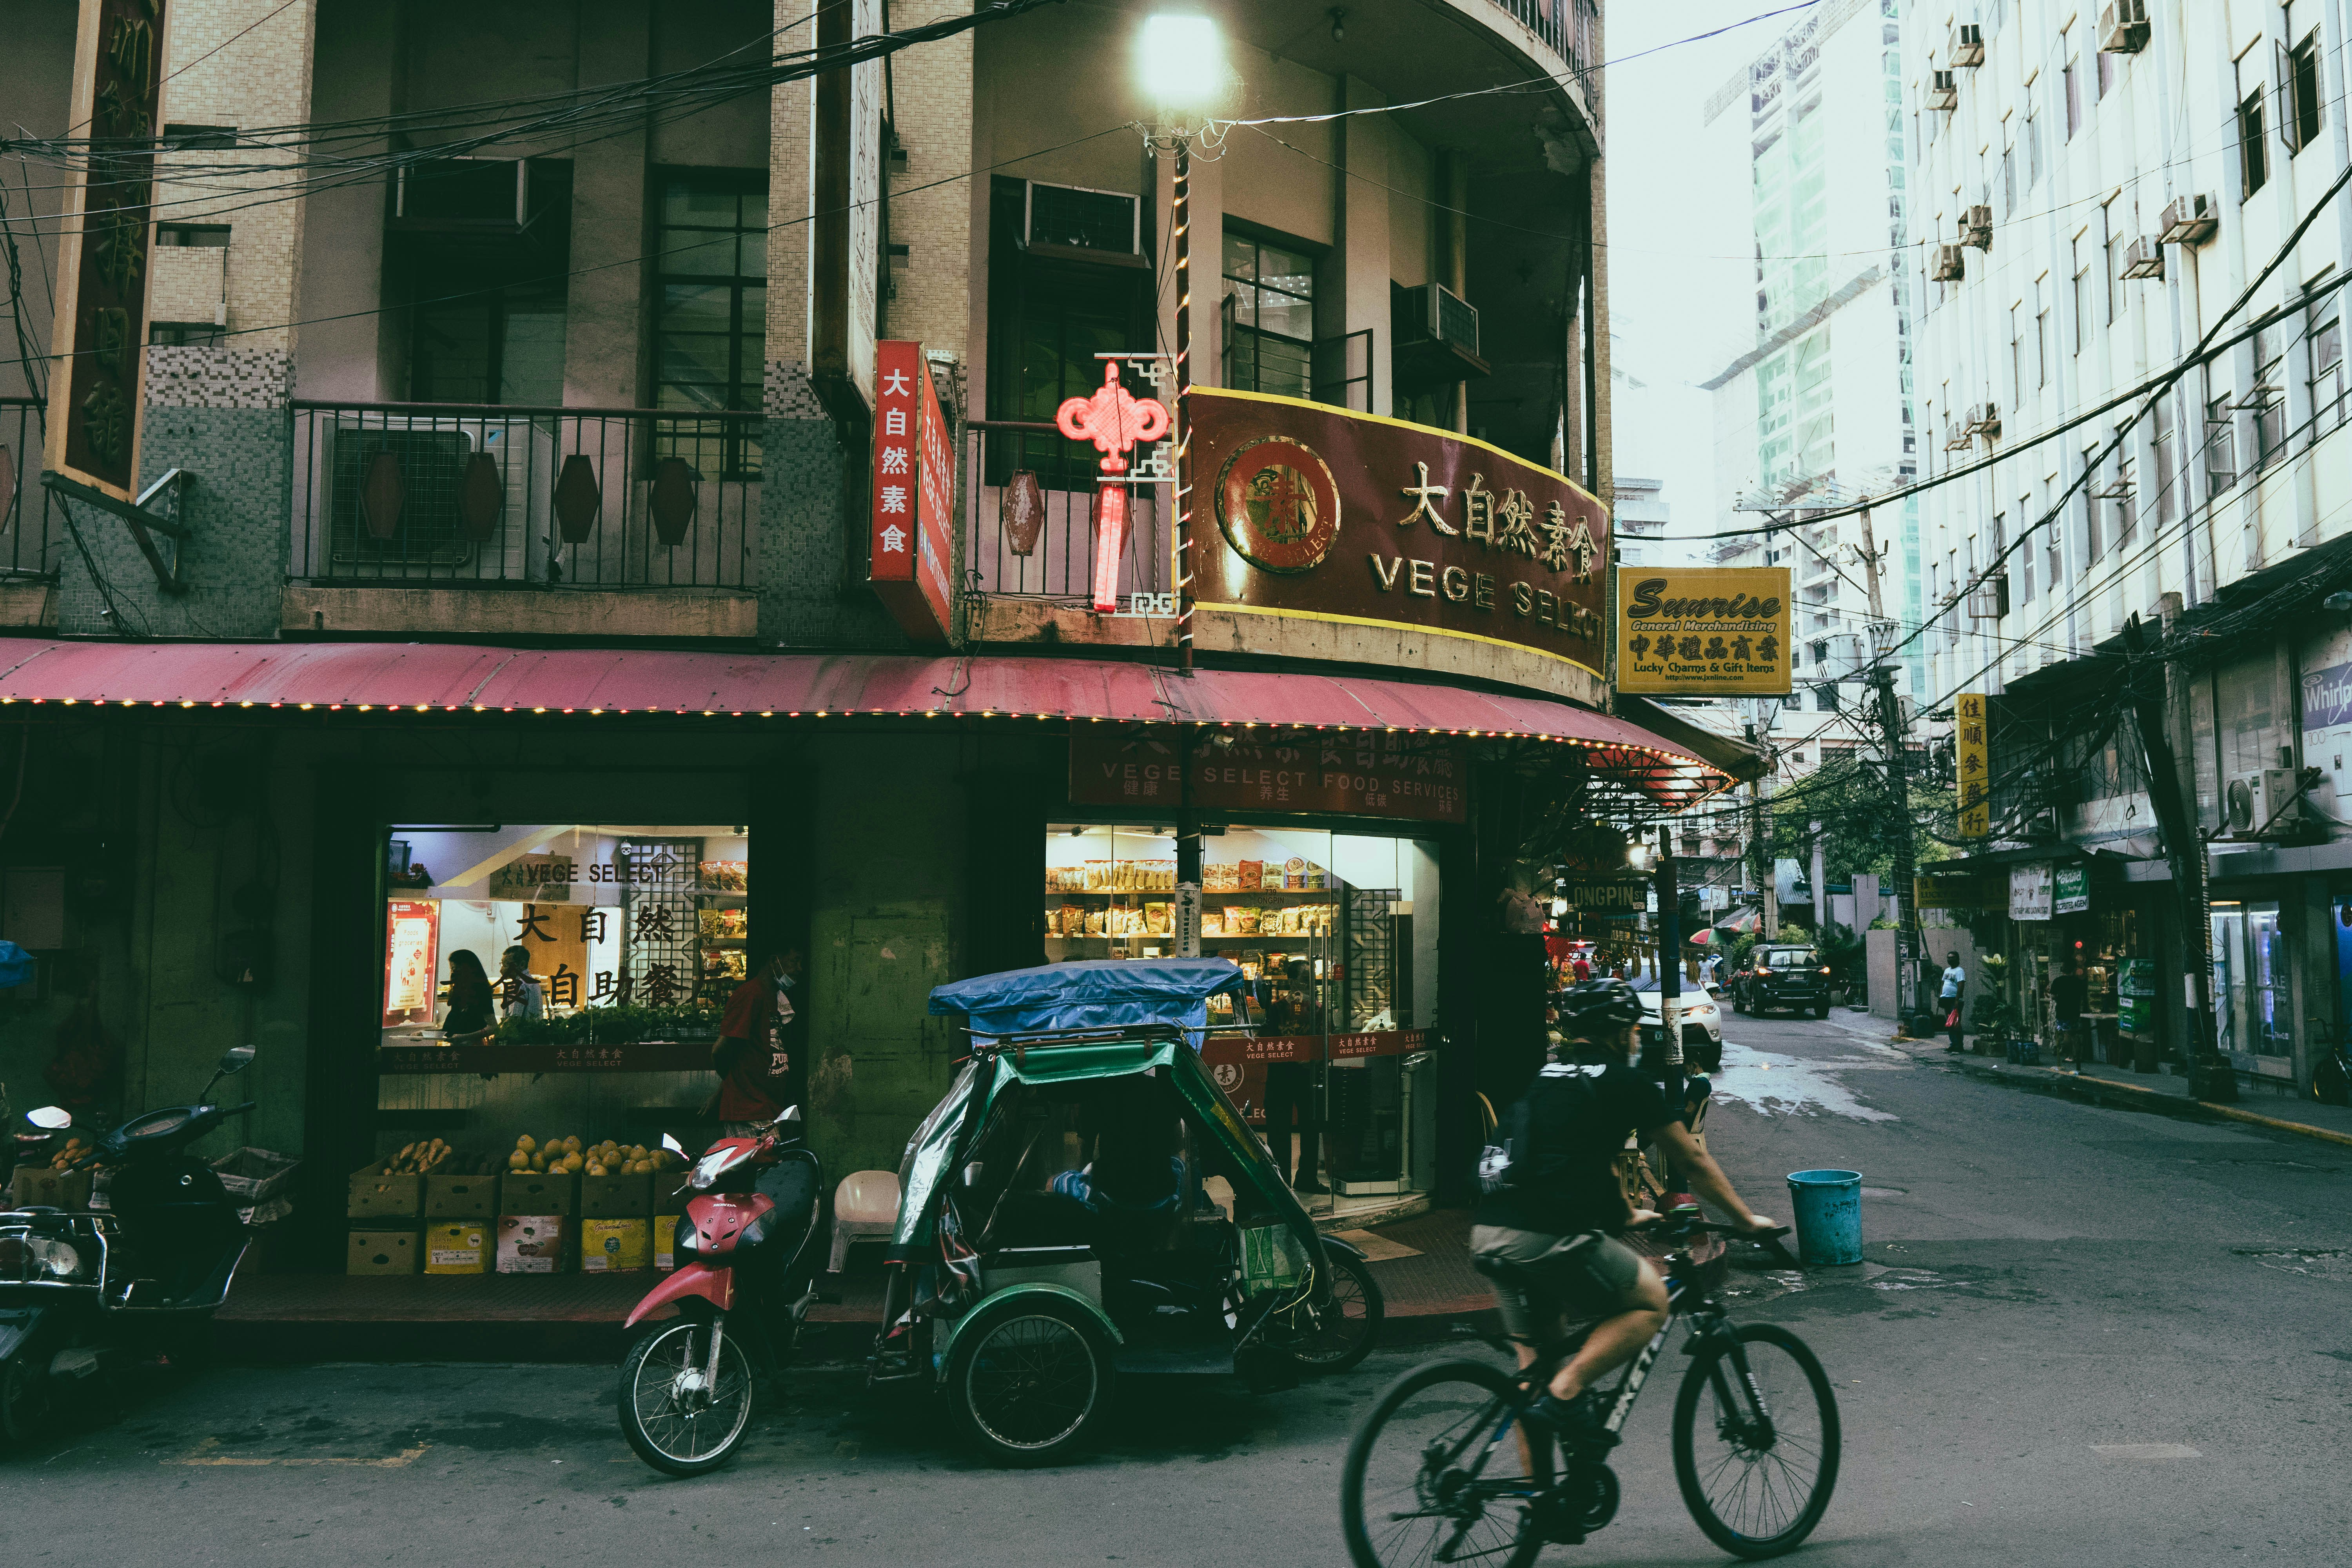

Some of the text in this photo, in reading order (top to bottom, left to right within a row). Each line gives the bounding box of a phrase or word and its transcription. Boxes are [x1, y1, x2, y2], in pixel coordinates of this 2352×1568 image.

[879, 368, 910, 554] 大自然素食
[925, 400, 951, 506] 大自然素食
[923, 454, 950, 549] VEGE SELECT
[1254, 473, 1308, 534] 素
[1398, 461, 1598, 585] 大自然素食
[1370, 553, 1602, 645] VEGE SELECT
[1627, 578, 1781, 619] Sunrise
[1632, 620, 1777, 633] General Merchandising
[1629, 634, 1779, 661] 中華禮品商業
[1634, 662, 1775, 675] Lucky Charms & Gift Items
[1102, 762, 1459, 800] VEGE SELECT FOOD SERVICES
[1123, 780, 1158, 796] 健康
[1260, 785, 1289, 800] 养生
[1365, 793, 1387, 807] 低碳
[527, 864, 579, 882] VEGE
[589, 864, 663, 883] SELECT
[1574, 886, 1633, 906] ONGPIN
[1634, 891, 1646, 900] ST.
[513, 903, 676, 945] 大自然
[1246, 1040, 1295, 1052] 大自然素食
[1339, 1036, 1377, 1047] 大自然素食
[394, 1051, 461, 1062] 大自然素食
[556, 1048, 624, 1060] 大自然素食
